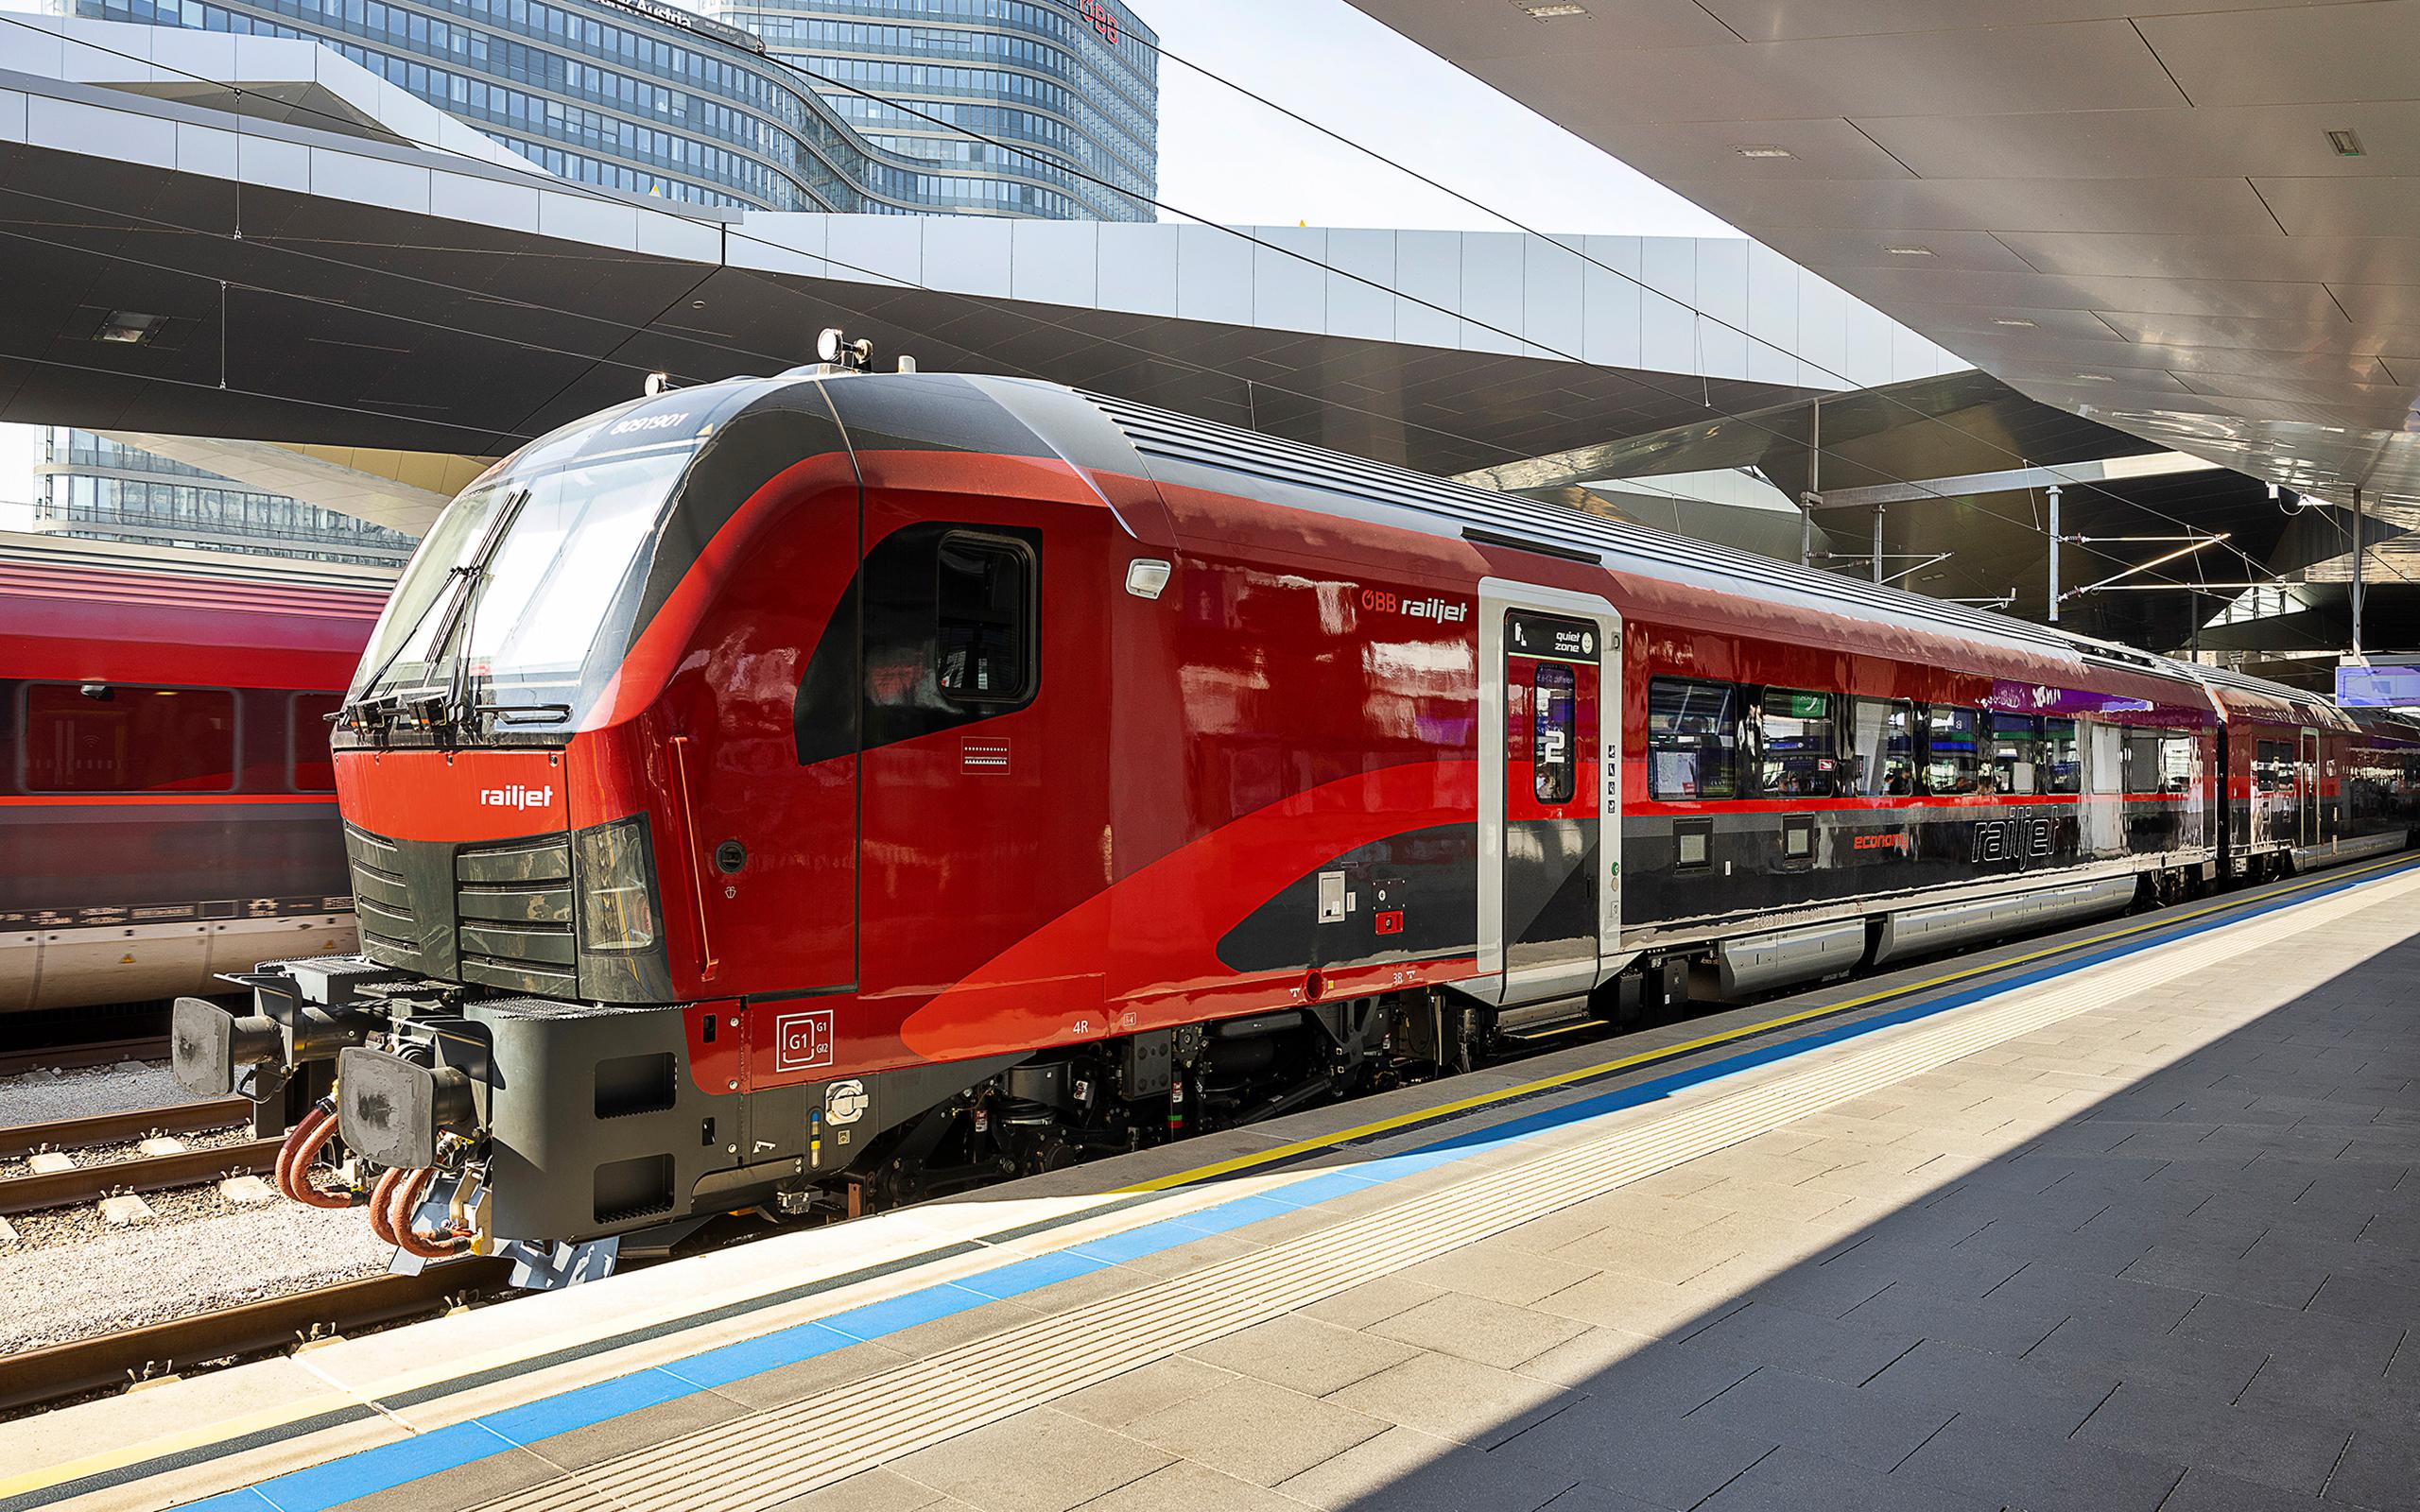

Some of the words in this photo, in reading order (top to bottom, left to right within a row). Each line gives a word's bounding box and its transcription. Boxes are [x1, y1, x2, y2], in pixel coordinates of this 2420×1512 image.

[1361, 589, 1396, 613] ÖBB
[1401, 597, 1467, 624] railjet
[1556, 630, 1581, 643] quiet
[1555, 643, 1580, 653] zone
[1545, 730, 1565, 764] 2
[480, 784, 554, 811] railjet
[1853, 832, 1909, 850] economy
[1971, 805, 2060, 870] railjet
[1392, 971, 1403, 984] 3R
[816, 1022, 827, 1032] G1
[1073, 1020, 1088, 1034] 4R
[789, 1033, 807, 1050] G1
